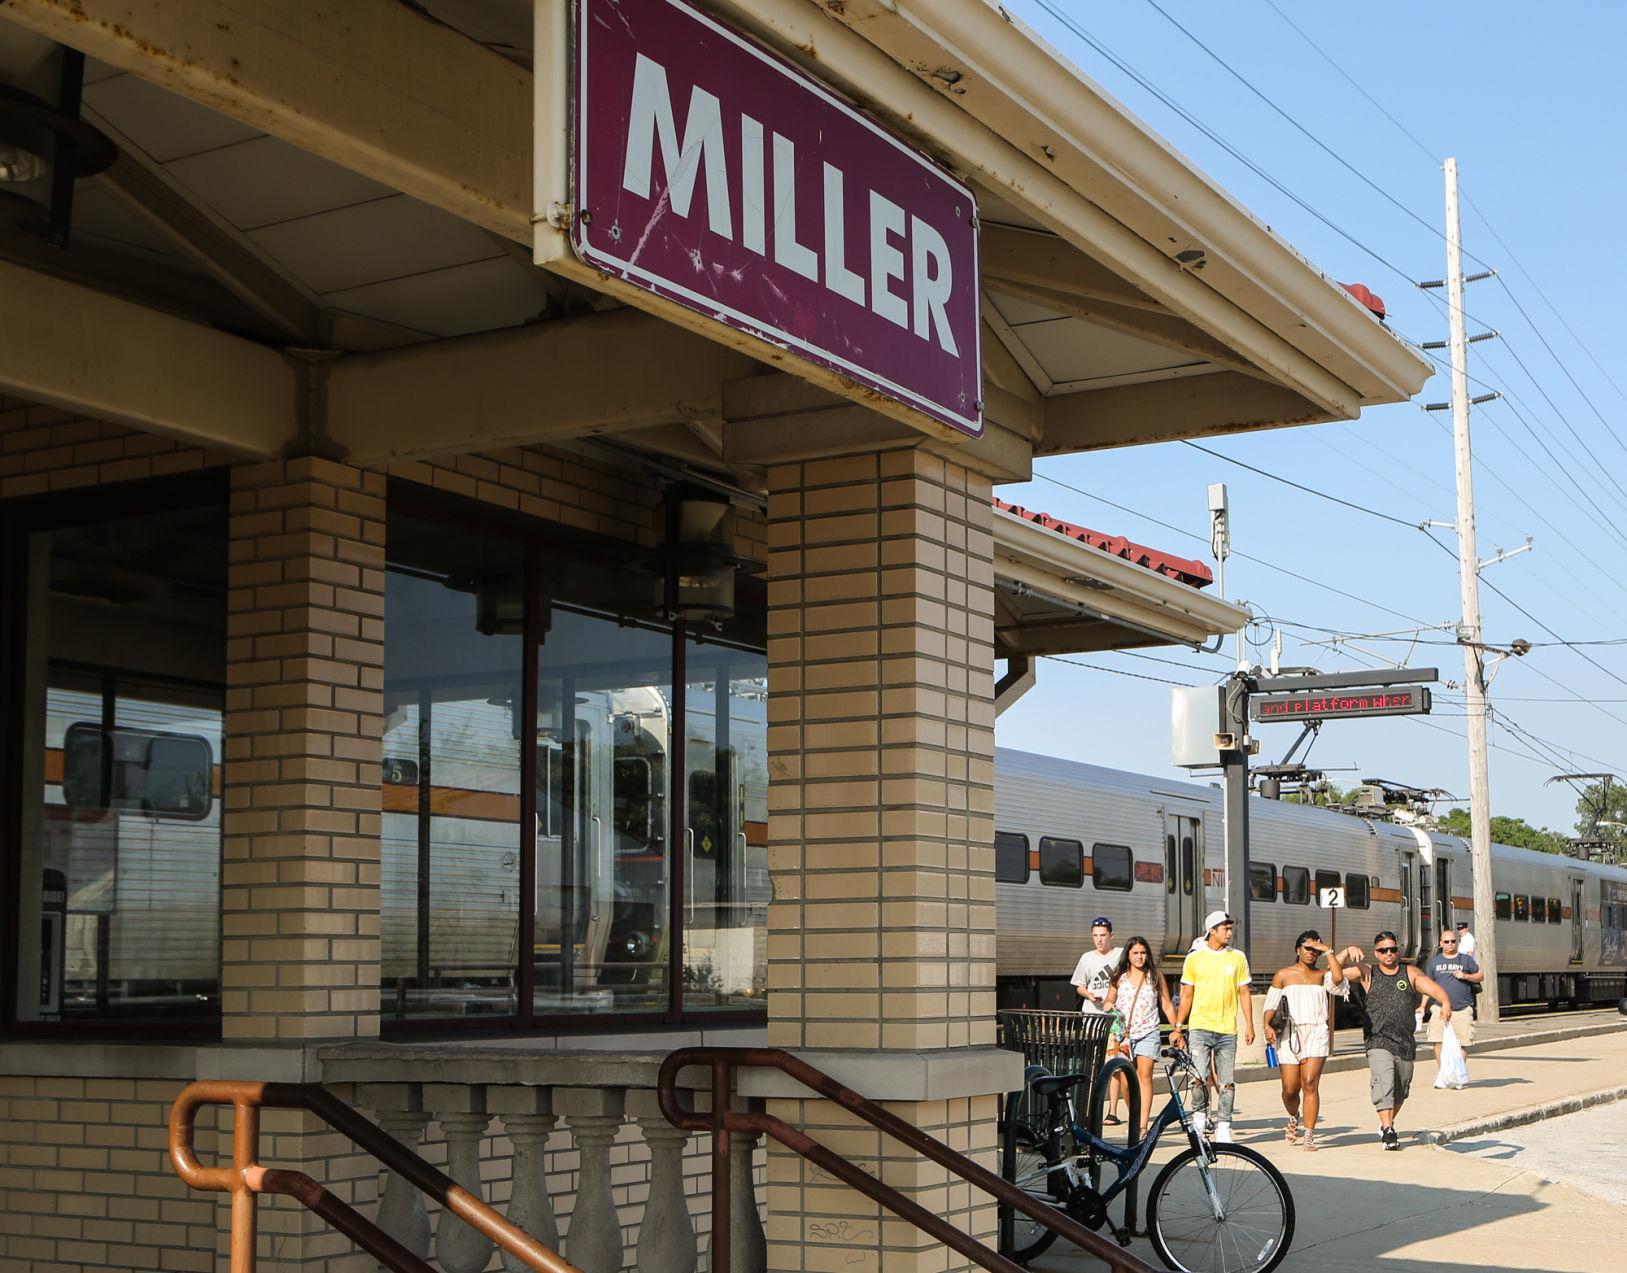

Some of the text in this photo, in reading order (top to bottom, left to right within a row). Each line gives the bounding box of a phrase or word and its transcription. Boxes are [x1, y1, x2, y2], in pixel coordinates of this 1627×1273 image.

[622, 51, 960, 359] MILLER
[1328, 889, 1339, 906] 2
[1435, 963, 1463, 972] OLD NAVY
[1092, 981, 1110, 990] adid
